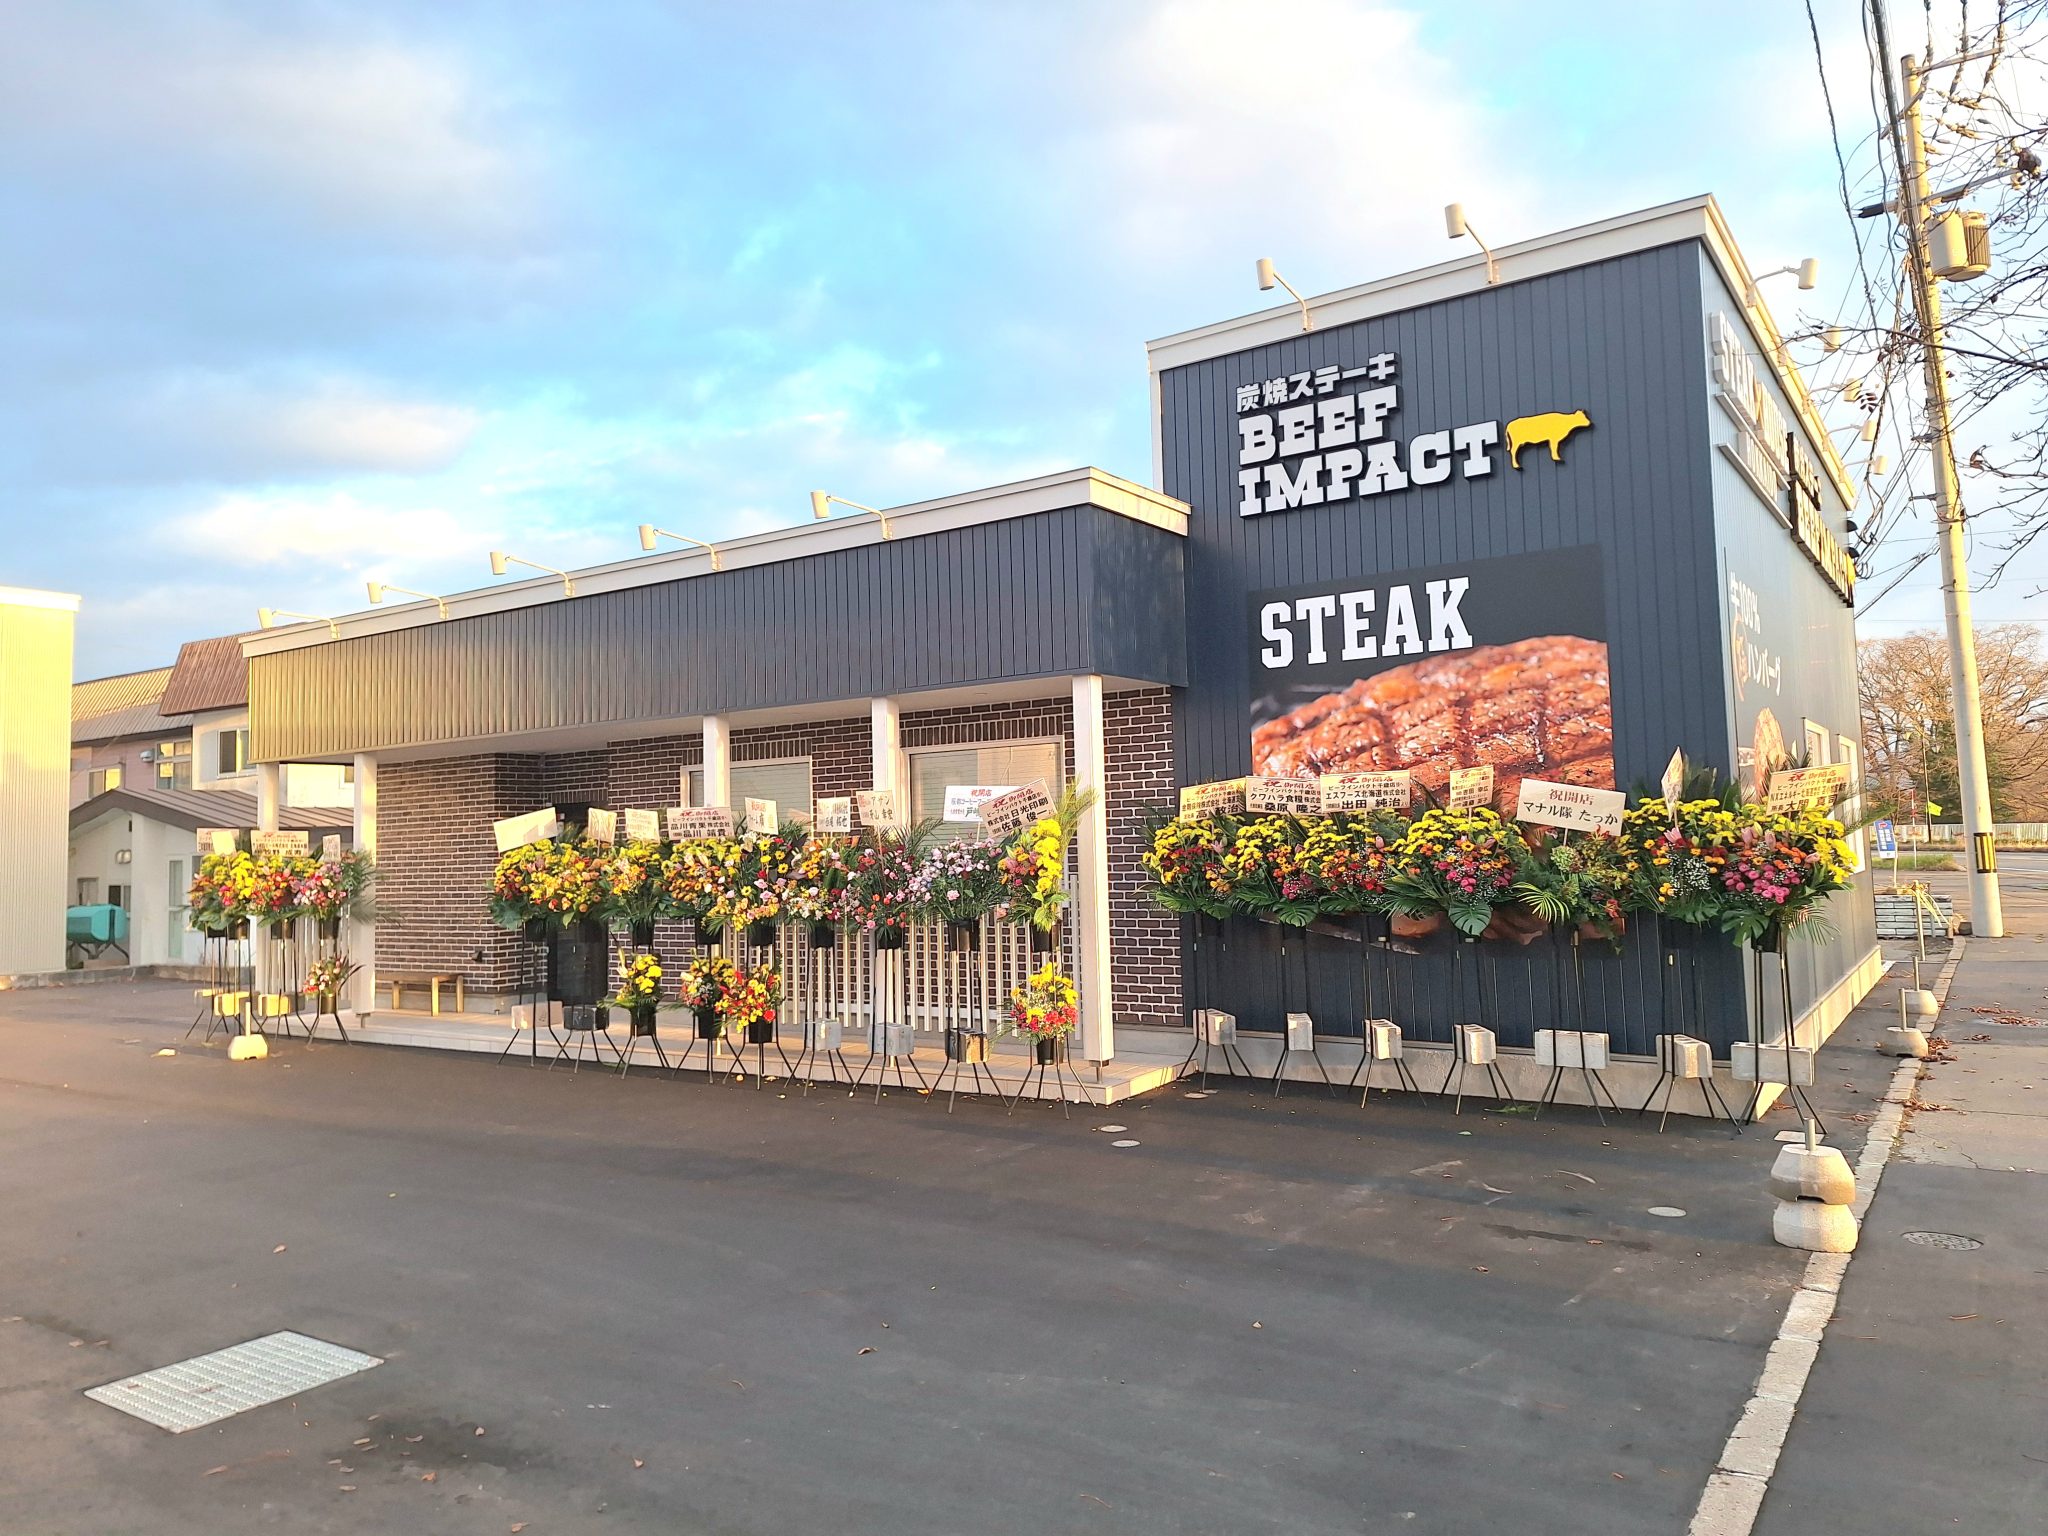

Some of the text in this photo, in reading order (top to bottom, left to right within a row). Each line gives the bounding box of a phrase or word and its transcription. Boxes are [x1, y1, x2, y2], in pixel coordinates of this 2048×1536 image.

[1236, 352, 1398, 413] 炭焼ステーキ
[1238, 384, 1399, 466] BEEF
[1237, 420, 1500, 518] IMPACT
[1260, 576, 1473, 669] STEAK
[1342, 799, 1367, 809] 出田
[1549, 788, 1594, 806] 祝開店
[1001, 817, 1023, 832] 佐藤
[1523, 801, 1618, 825] マナル隊 たっか
[683, 830, 702, 838] 品川
